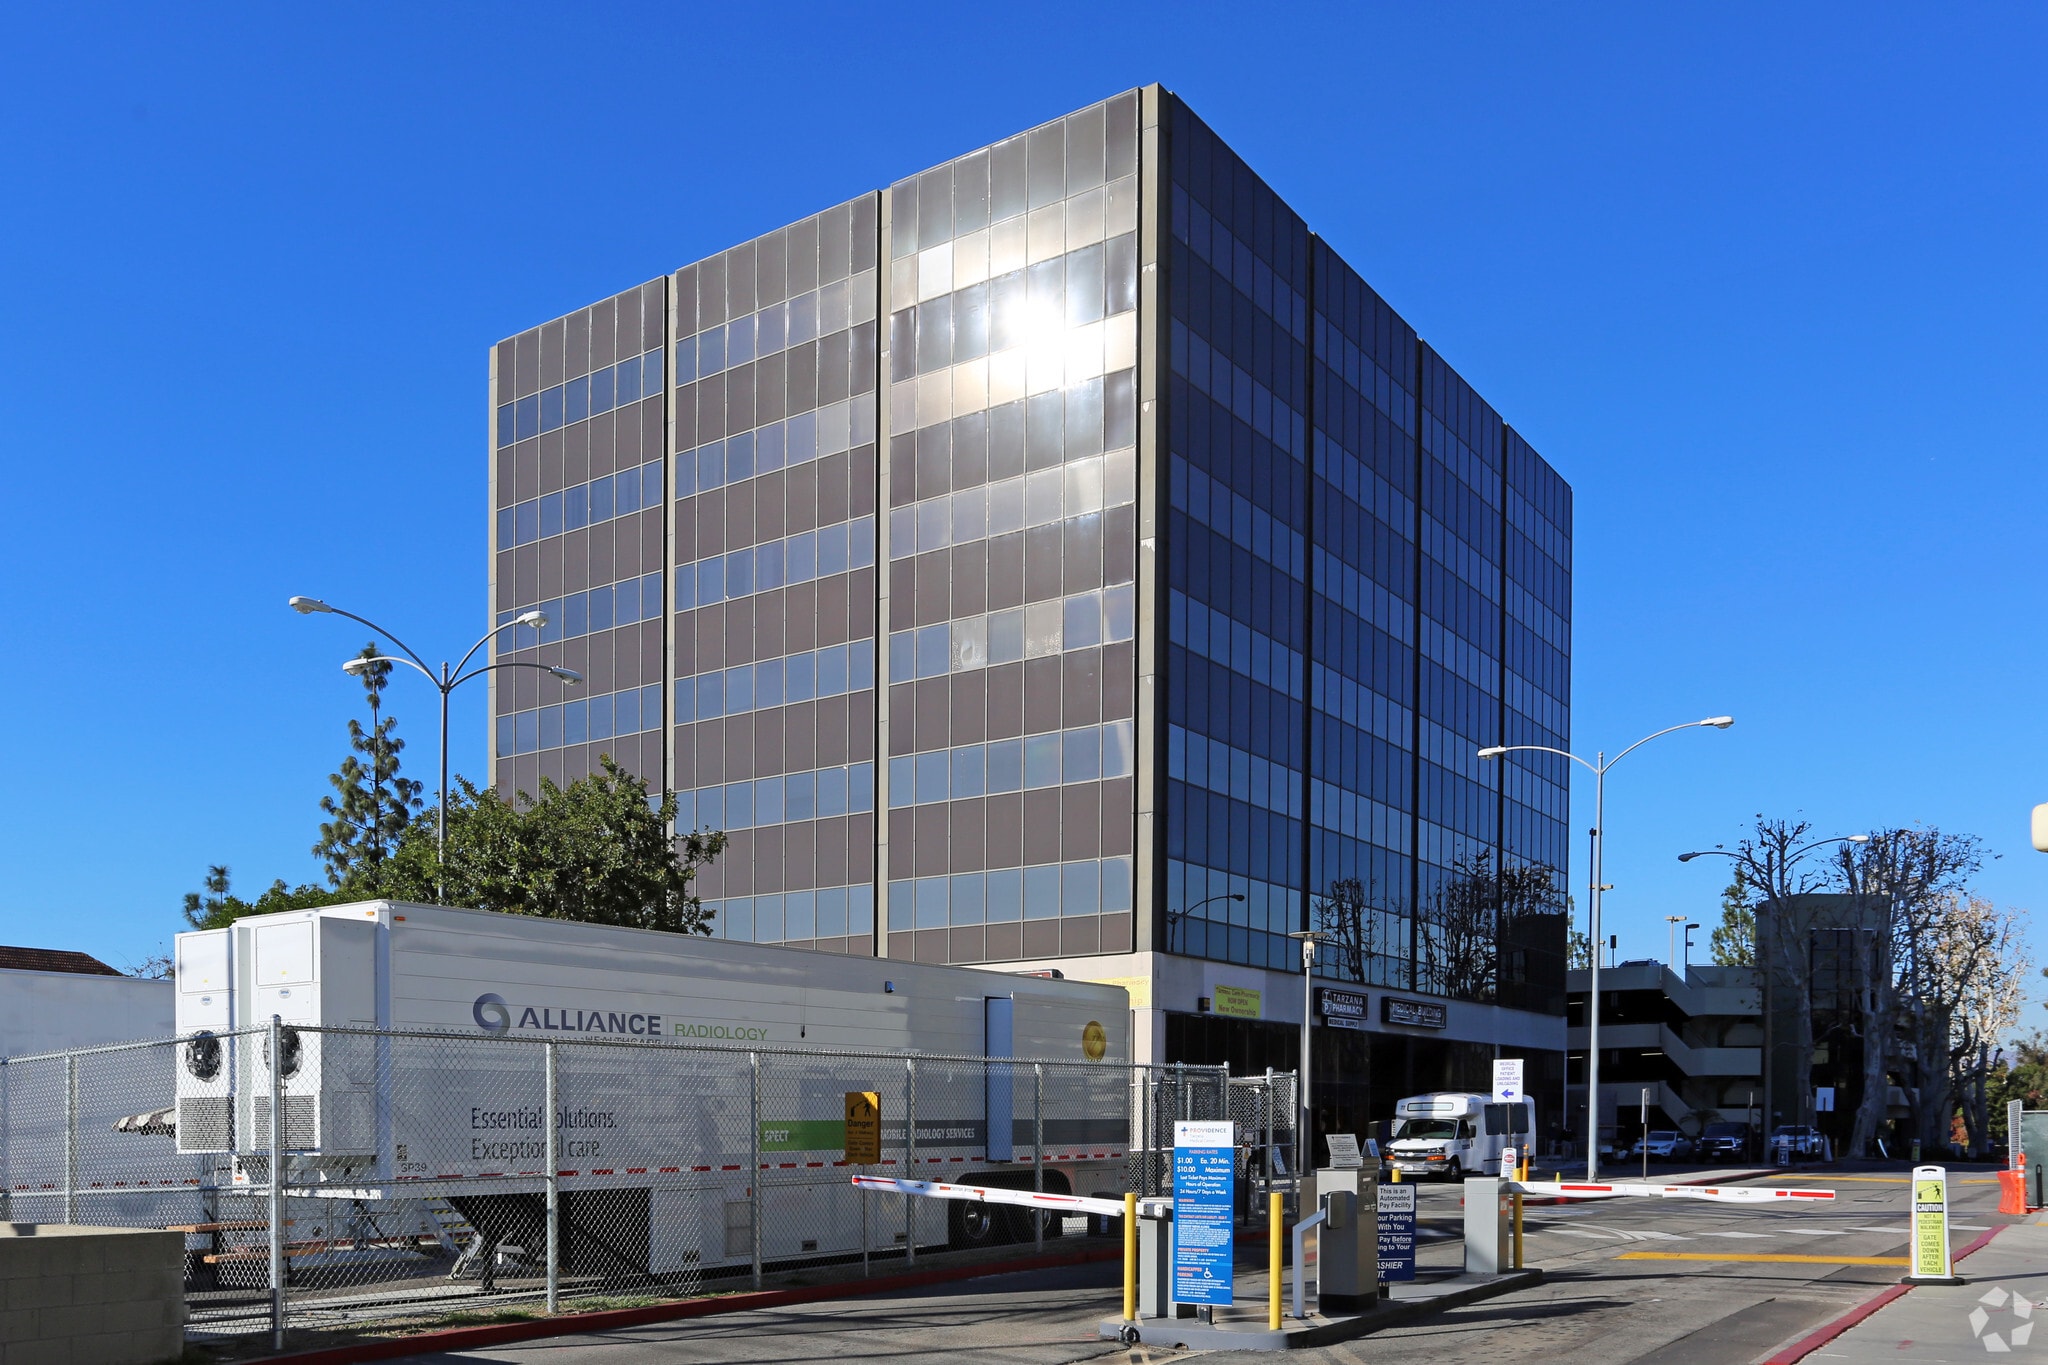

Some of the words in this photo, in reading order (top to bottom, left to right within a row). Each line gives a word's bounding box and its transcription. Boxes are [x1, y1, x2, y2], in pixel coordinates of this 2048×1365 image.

[1237, 998, 1249, 1006] OPEN
[1333, 994, 1363, 1006] TARZANA
[1218, 1004, 1230, 1012] New
[1231, 1006, 1257, 1016] Ownership
[1332, 1003, 1363, 1015] PHARMACY
[1392, 1003, 1416, 1015] MEDICAL
[1417, 1006, 1442, 1018] BUILDING
[518, 1007, 662, 1036] ALLIANCE
[675, 1023, 768, 1041] RADIOLOGY
[471, 1106, 542, 1129] Essential
[551, 1105, 617, 1129] olutions.
[848, 1119, 874, 1129] Danger
[911, 1128, 944, 1140] DIOLOGY
[945, 1127, 976, 1139] SERVICES
[472, 1135, 564, 1164] Exceptionl
[1917, 1203, 1943, 1212] CAUTION
[1389, 1214, 1412, 1222] Parking
[1379, 1236, 1390, 1244] Pay
[1377, 1261, 1403, 1269] ASHIER
